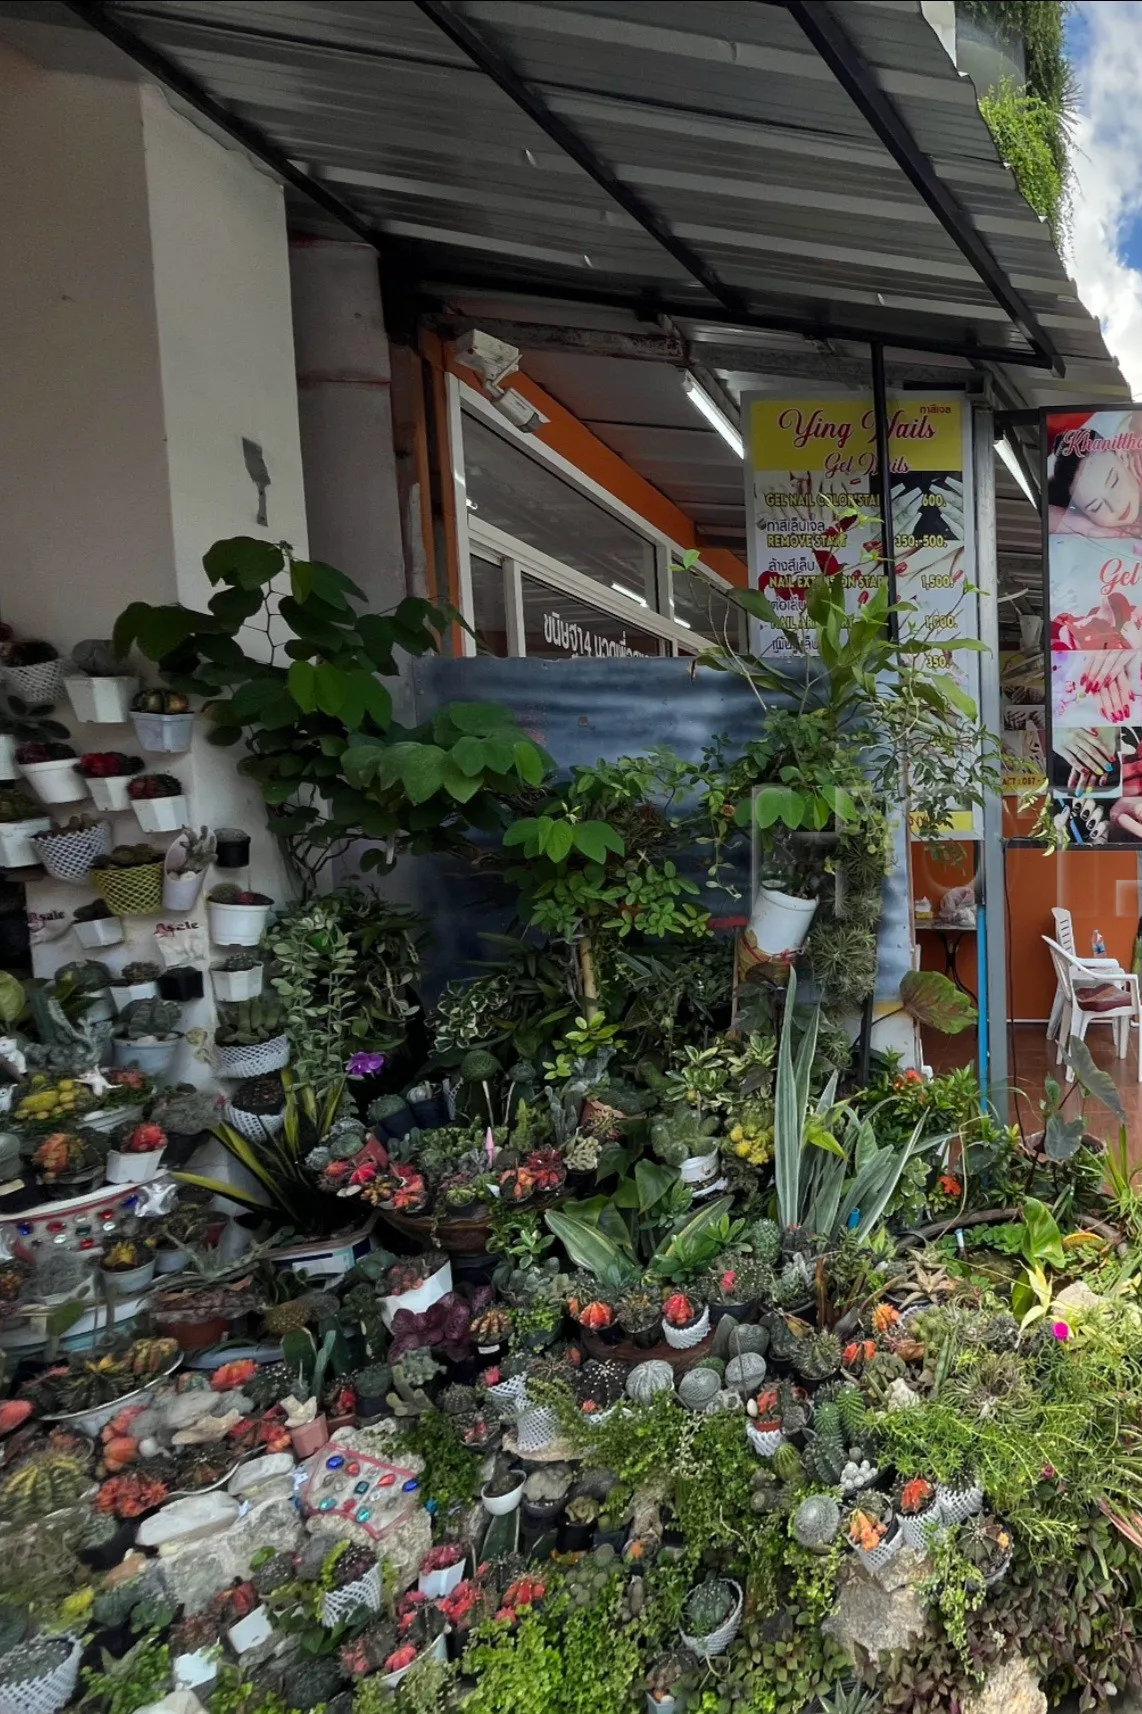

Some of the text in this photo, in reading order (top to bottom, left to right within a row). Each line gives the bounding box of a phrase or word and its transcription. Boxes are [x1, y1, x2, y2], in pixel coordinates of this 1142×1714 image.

[778, 408, 853, 448] Ying
[824, 452, 853, 479] Gel
[765, 494, 788, 507] GEL
[789, 494, 816, 507] NAIL
[857, 494, 882, 508] STA
[767, 534, 813, 548] REMOVE
[769, 575, 797, 589] NAIL
[1099, 558, 1141, 596] Gel
